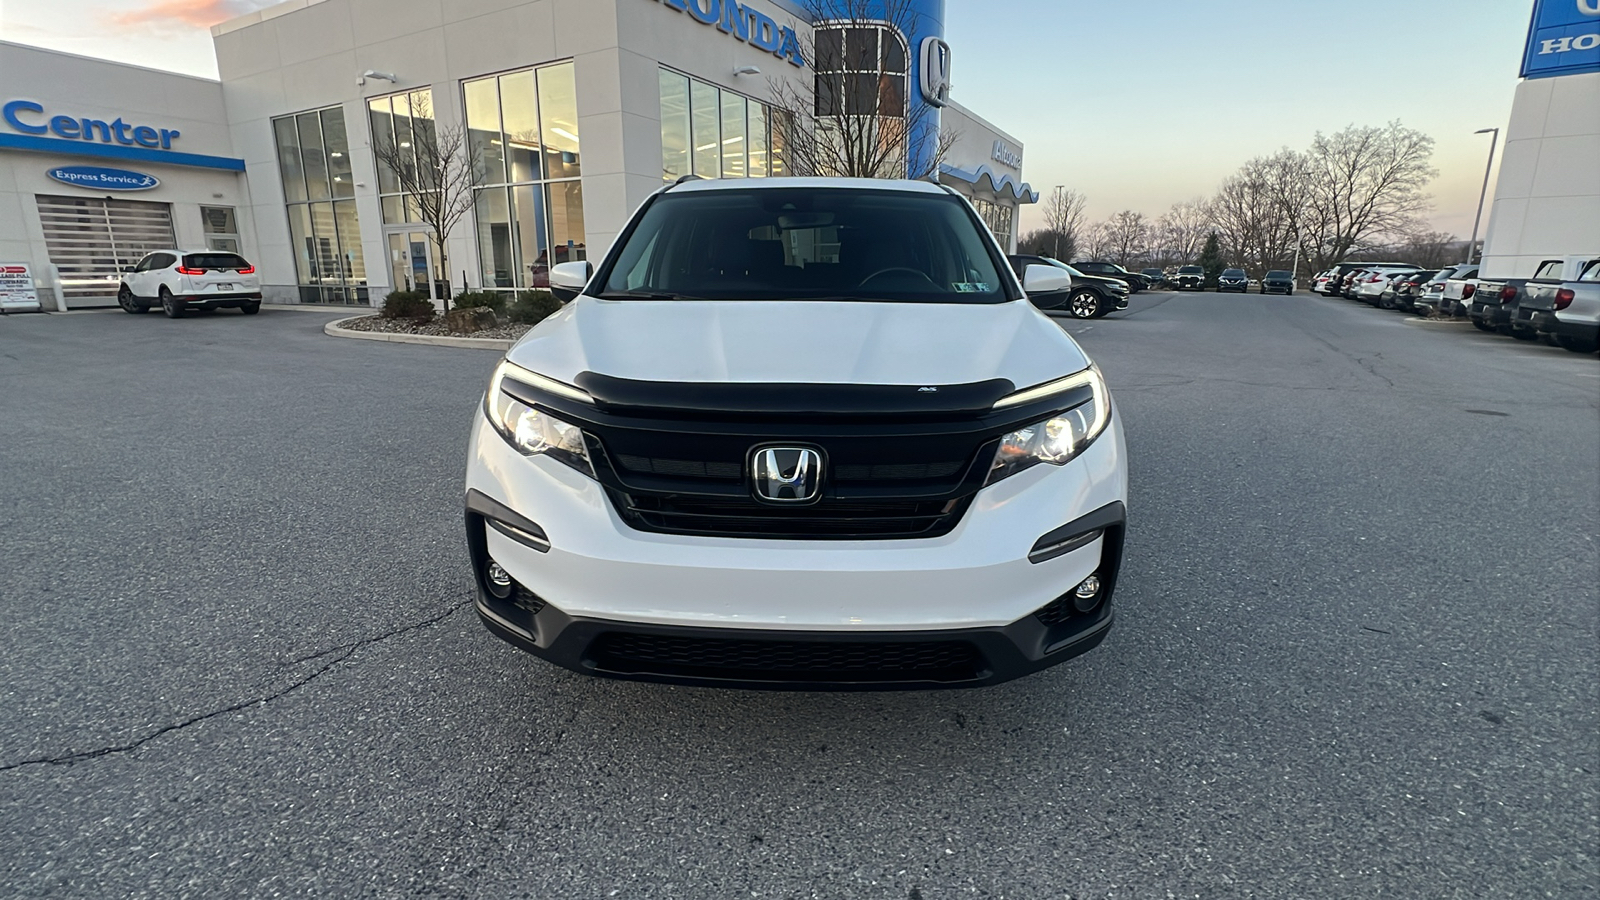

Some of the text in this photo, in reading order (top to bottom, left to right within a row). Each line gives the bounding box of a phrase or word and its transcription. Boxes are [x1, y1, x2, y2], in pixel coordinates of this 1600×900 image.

[654, 0, 804, 68] ONDA
[2, 100, 180, 149] Center
[56, 170, 138, 184] Express Service
